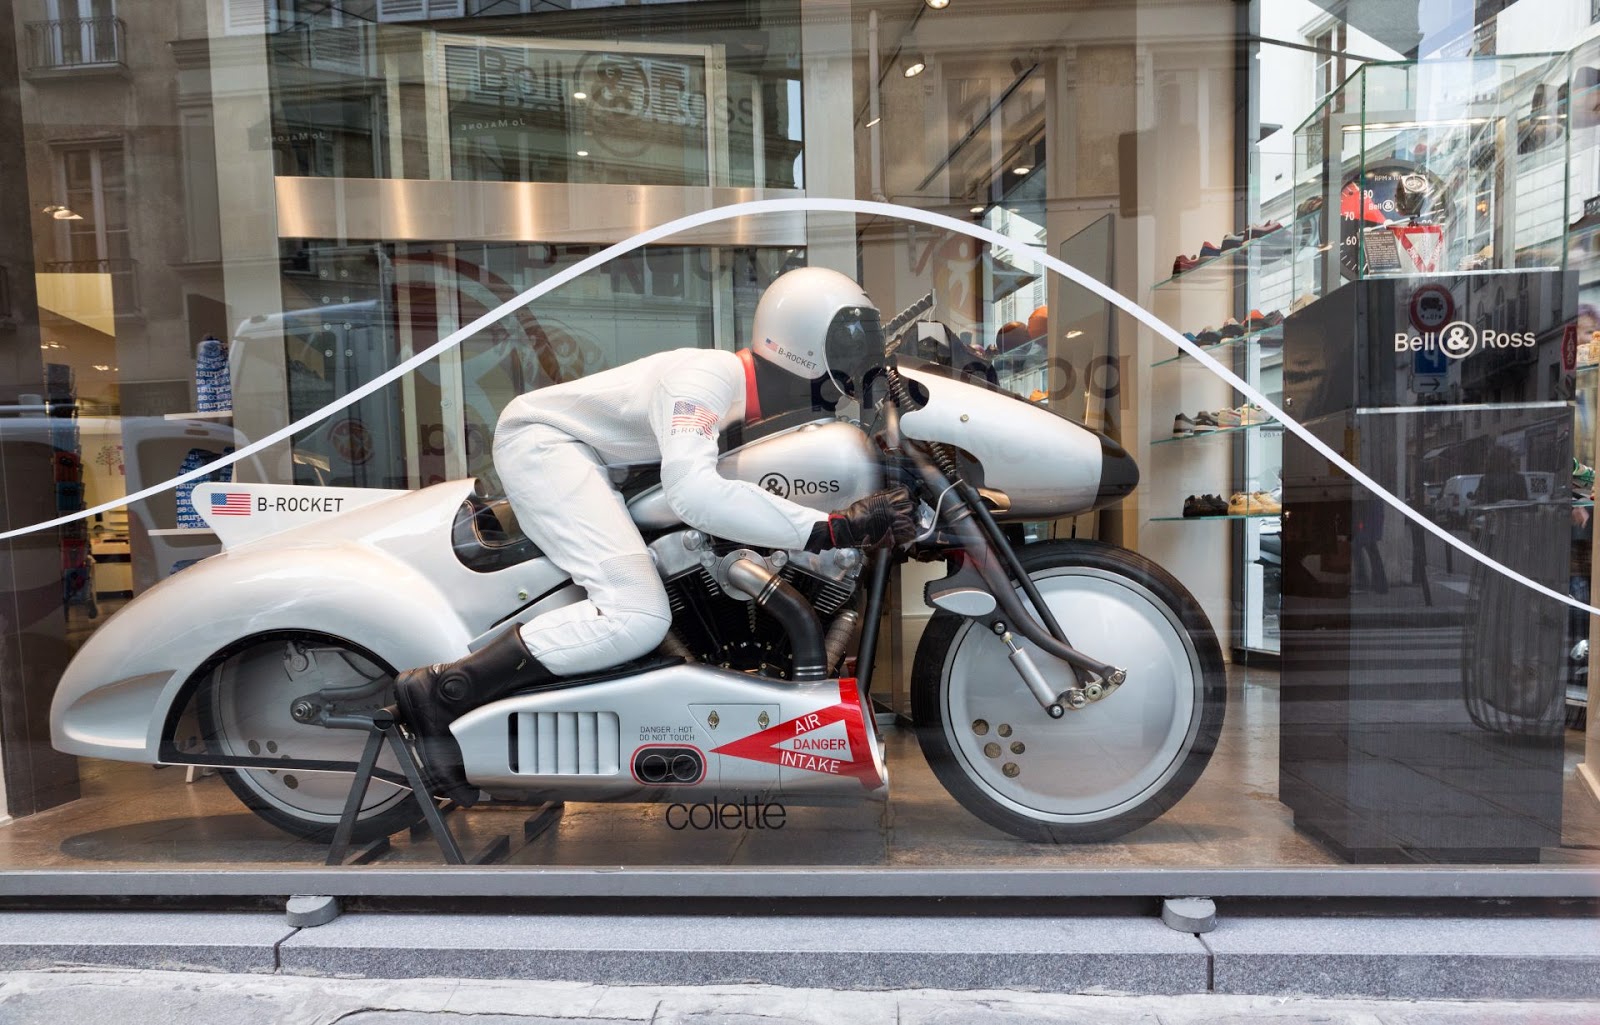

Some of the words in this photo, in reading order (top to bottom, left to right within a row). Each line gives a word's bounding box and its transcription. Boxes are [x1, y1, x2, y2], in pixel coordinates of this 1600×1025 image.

[1344, 211, 1355, 221] 70
[1346, 236, 1357, 246] 60
[1394, 332, 1435, 352] Bell
[1481, 329, 1536, 349] Ross
[778, 347, 817, 371] B-ROCKET
[793, 479, 840, 495] Ross
[257, 497, 344, 512] B-ROCKET
[795, 713, 821, 735] AIR
[793, 739, 847, 750] DANGER
[780, 751, 841, 774] INTAKE
[665, 795, 787, 830] colette
